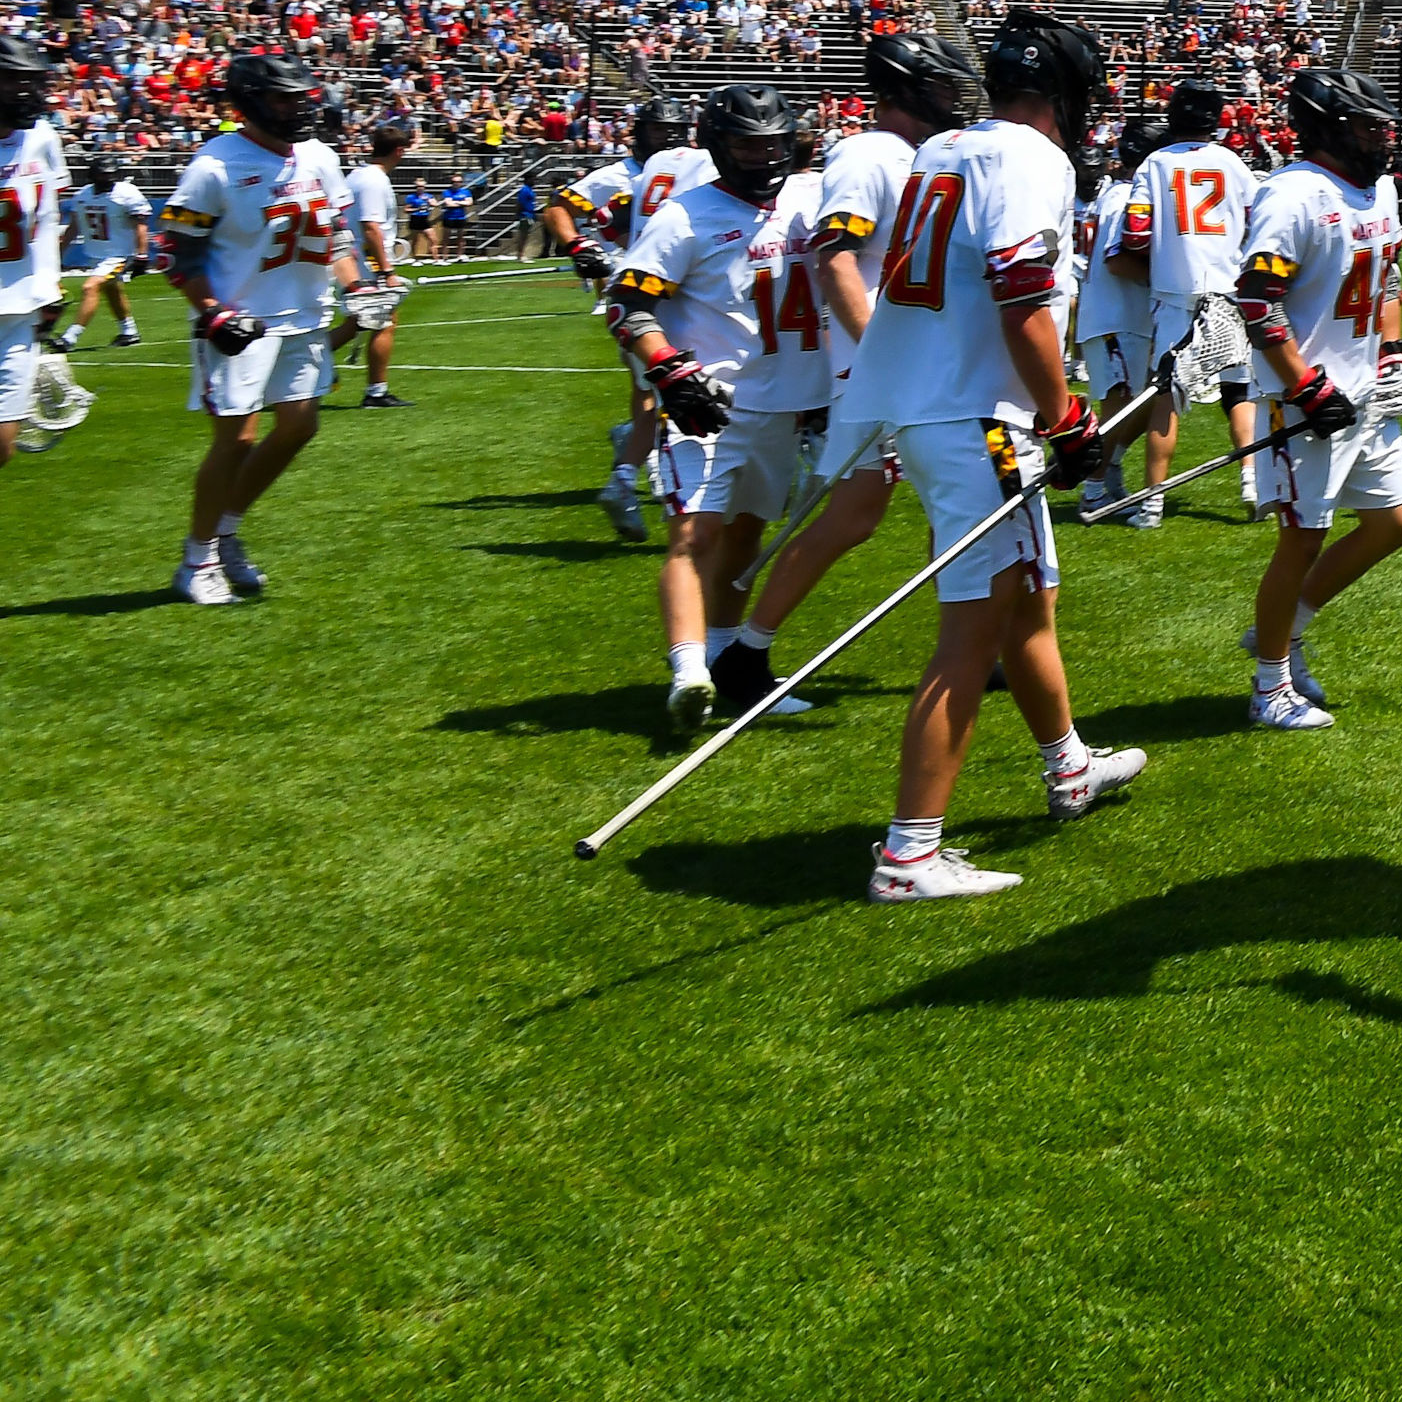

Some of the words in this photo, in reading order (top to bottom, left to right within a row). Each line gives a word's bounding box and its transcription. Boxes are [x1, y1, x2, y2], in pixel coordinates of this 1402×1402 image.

[260, 197, 332, 273] 35
[1169, 168, 1227, 236] 12
[750, 261, 820, 355] 14
